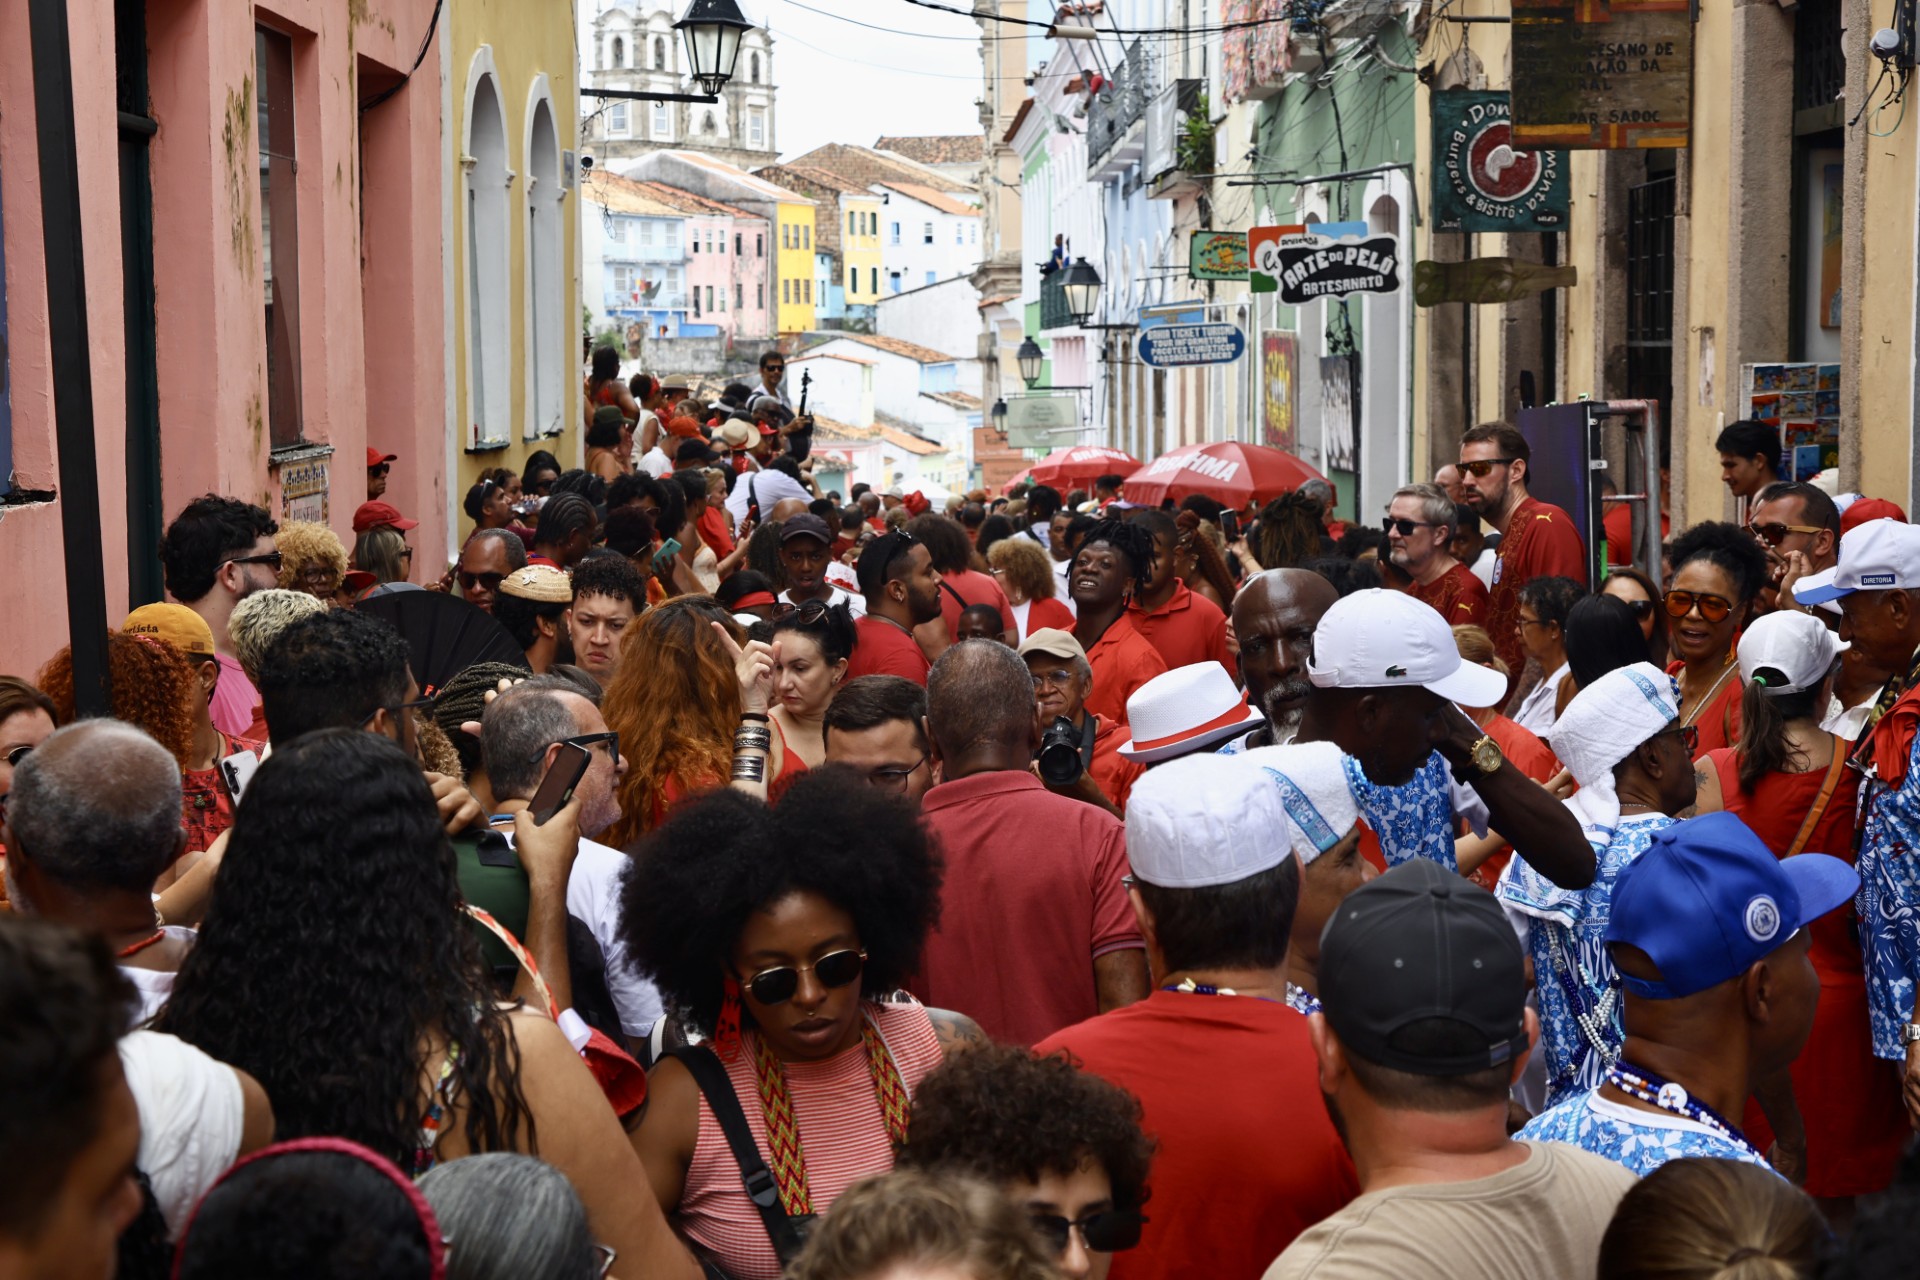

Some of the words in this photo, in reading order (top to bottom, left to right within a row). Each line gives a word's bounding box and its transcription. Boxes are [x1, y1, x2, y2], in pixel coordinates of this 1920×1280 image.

[1655, 42, 1674, 56] DE
[1641, 59, 1661, 72] DA
[1608, 109, 1660, 123] SADOC
[1446, 130, 1467, 195] Burgers
[1465, 194, 1477, 206] &
[1283, 250, 1330, 290] ARTE
[1328, 250, 1344, 263] DO
[1302, 275, 1384, 296] ARTESANATO
[1171, 327, 1200, 338] TICKET
[1152, 339, 1173, 349] TOUR
[1174, 336, 1229, 347] INFORMATION
[1150, 346, 1187, 356] PACOTES
[1153, 353, 1201, 364] PASSAGENS
[1070, 448, 1131, 463] BRAHMA
[1149, 448, 1240, 482] BRAHMA
[1863, 576, 1893, 584] DIRETORIA
[1585, 917, 1609, 925] Gilson
